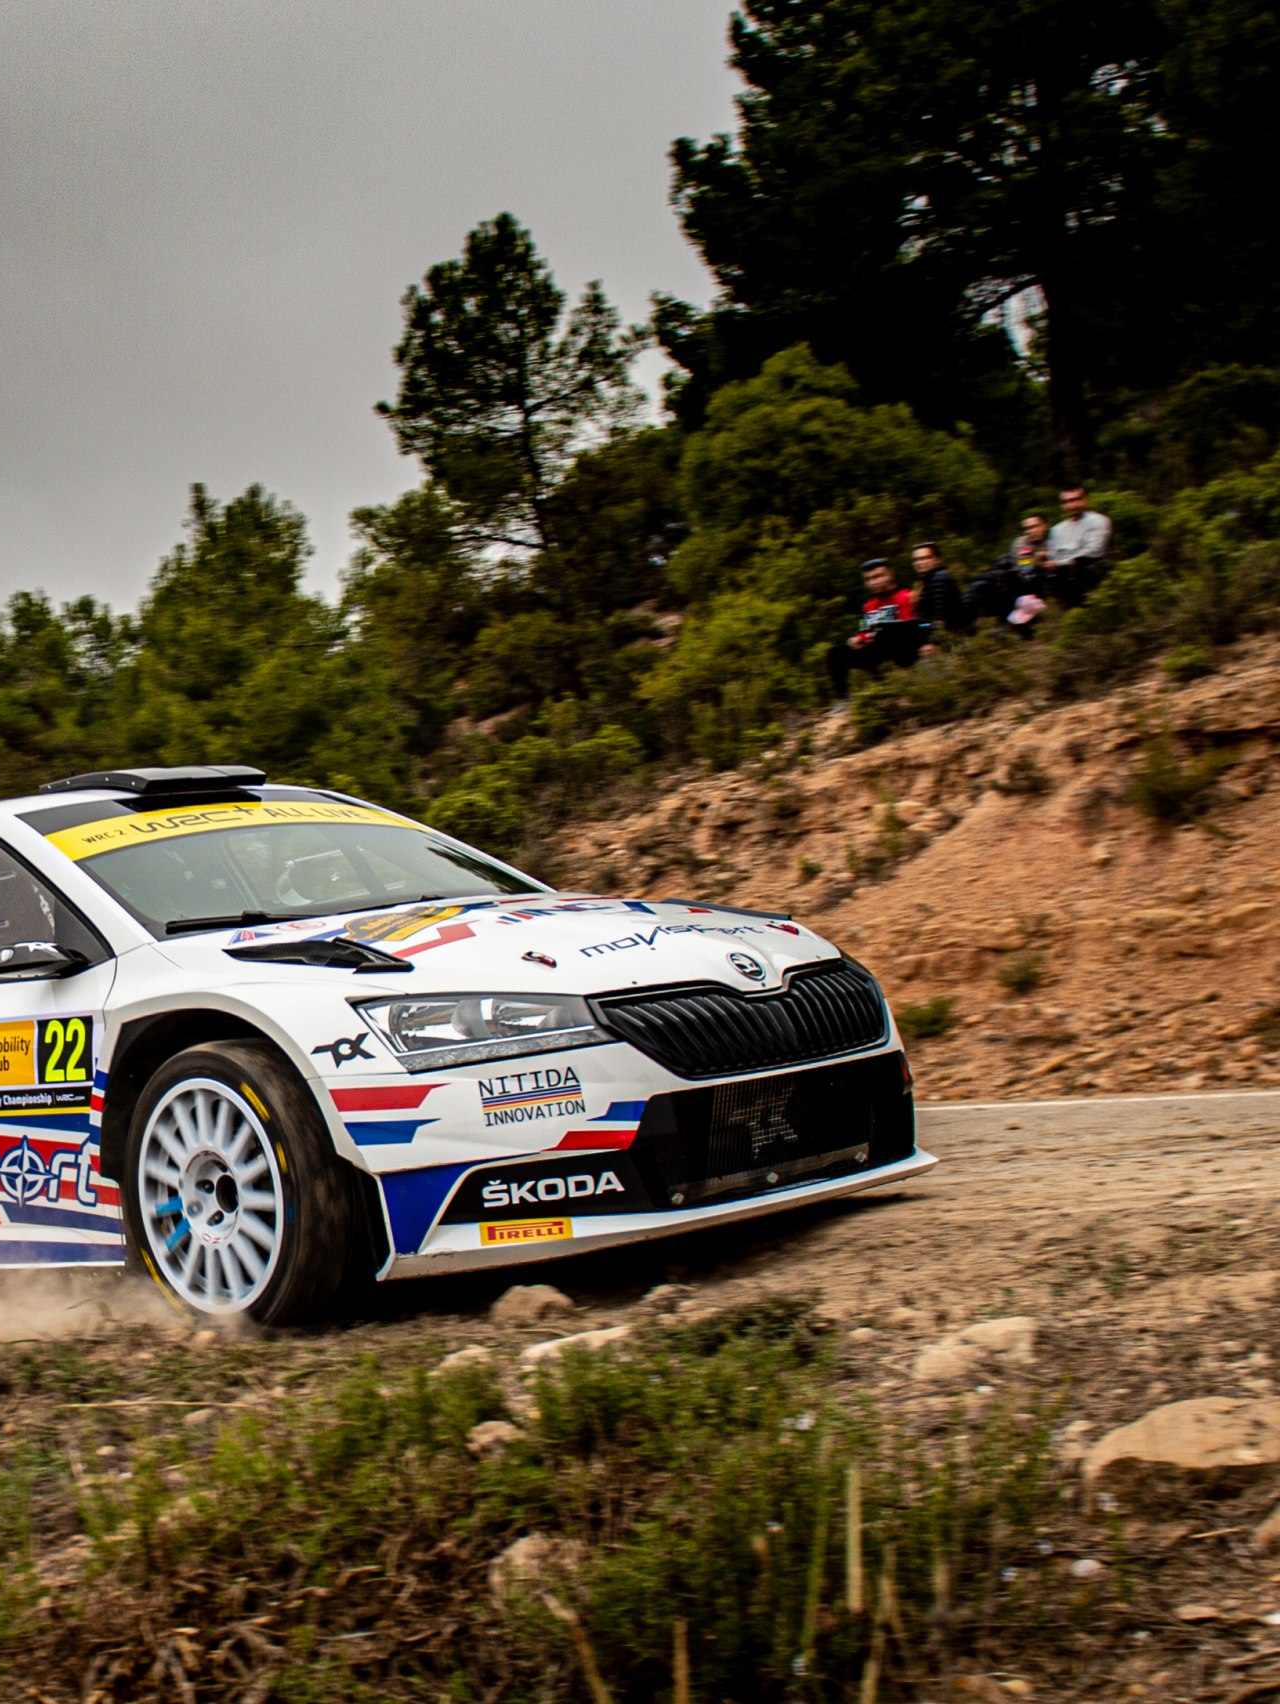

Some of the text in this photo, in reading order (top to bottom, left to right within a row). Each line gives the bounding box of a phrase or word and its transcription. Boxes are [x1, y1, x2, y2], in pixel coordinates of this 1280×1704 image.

[261, 806, 313, 819] ALL
[315, 808, 368, 820] LIVE
[82, 831, 116, 845] WRC
[44, 1018, 86, 1083] 22
[478, 1066, 580, 1098] NITIDA
[3, 1093, 52, 1107] Championship
[484, 1100, 586, 1127] INNOVATION
[482, 1171, 625, 1208] ŠKODA
[487, 1221, 564, 1241] PIRELLI
